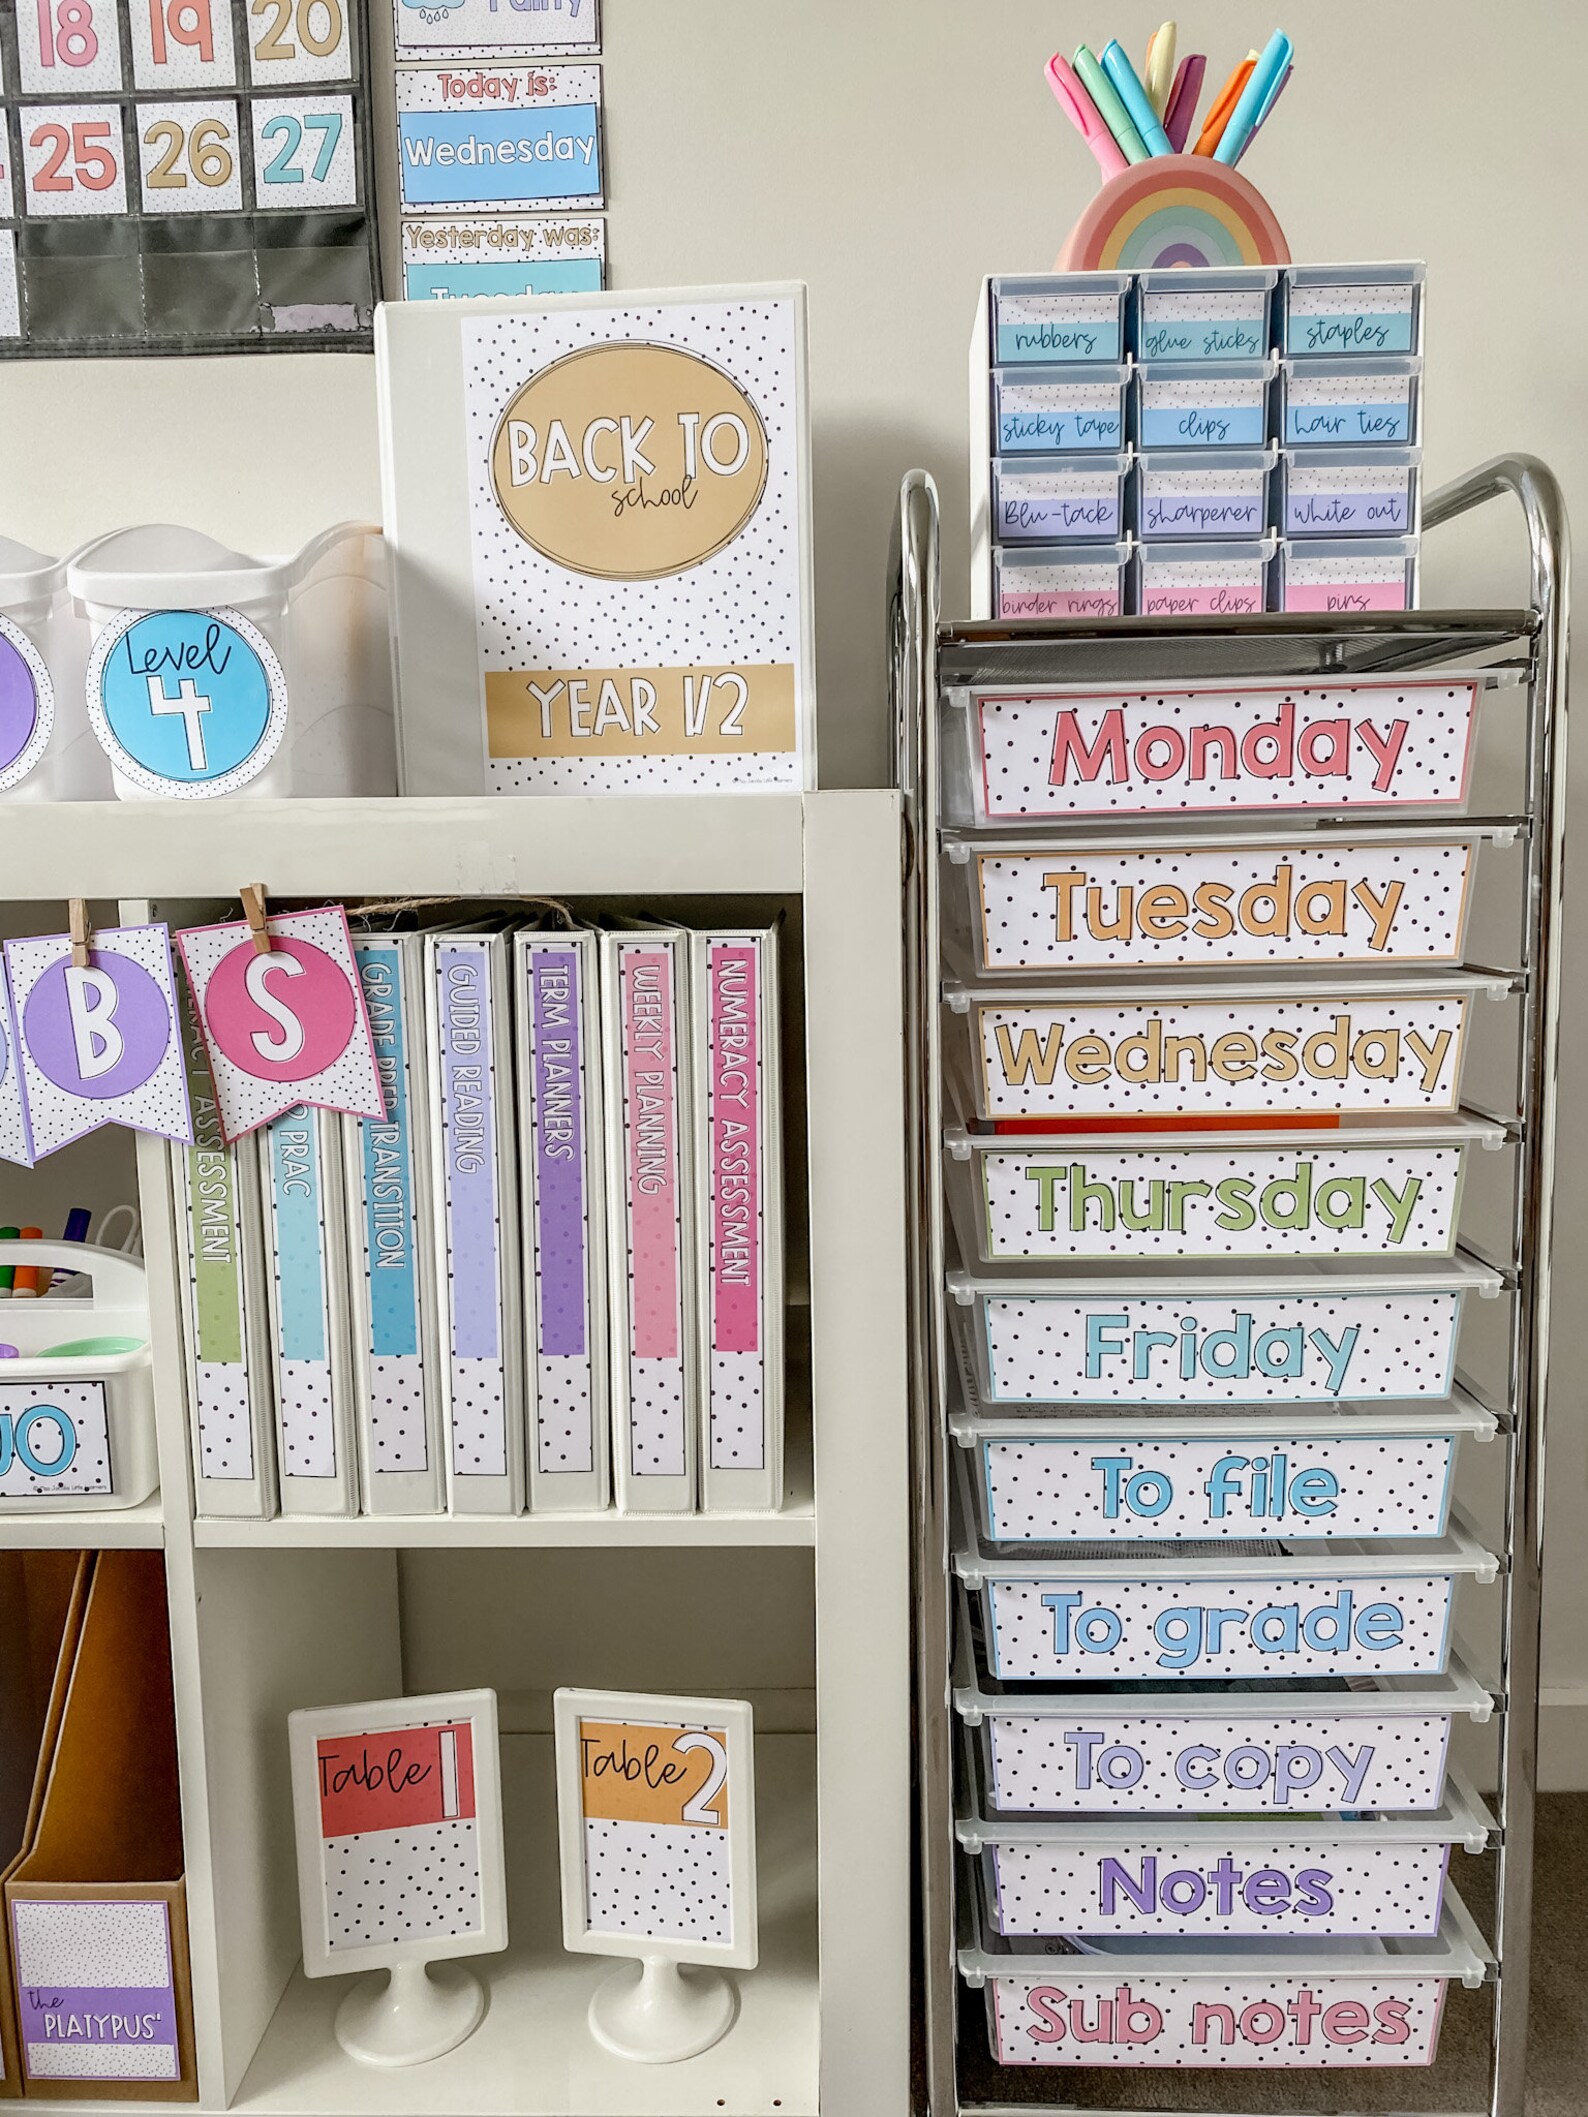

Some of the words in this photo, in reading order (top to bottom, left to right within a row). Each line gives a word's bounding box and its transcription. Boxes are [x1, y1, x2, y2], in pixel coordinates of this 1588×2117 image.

[37, 0, 98, 67] 18
[149, 0, 215, 64] 19
[251, 0, 342, 60] 20
[437, 72, 518, 103] Today
[527, 71, 557, 97] is:
[29, 121, 117, 191] 25
[143, 119, 232, 188] 26
[261, 113, 343, 184] 27
[404, 131, 595, 168] Wednesday
[406, 224, 534, 252] Yesterday
[543, 227, 600, 248] was:
[1015, 324, 1097, 353] rubbers
[1145, 327, 1192, 359] glue
[1203, 330, 1260, 355] sticks
[1305, 316, 1389, 349] staples
[507, 415, 656, 487] BACK
[678, 411, 750, 480] TO
[1003, 417, 1064, 445] sticky
[1075, 416, 1120, 444] tape
[1178, 411, 1230, 441] clips
[1294, 410, 1346, 435] hair
[1357, 410, 1400, 437] ties
[611, 475, 698, 517] school
[1004, 499, 1113, 528] Blu-tack
[1147, 498, 1258, 528] sharpener
[1294, 498, 1356, 523] white
[1367, 499, 1401, 522] out
[1002, 591, 1057, 615] binder
[1067, 598, 1118, 616] rings
[1147, 597, 1199, 615] paper
[1210, 588, 1257, 613] clips
[1326, 592, 1371, 613] pins
[126, 624, 232, 675] Level
[146, 675, 211, 770] 4
[526, 677, 661, 739] YEAR
[683, 672, 749, 738] 1/2
[1048, 703, 1409, 792] Monday
[1042, 864, 1405, 951] Tuesday
[63, 966, 124, 1080] B
[245, 952, 307, 1063] S
[360, 961, 393, 1047] GRADE
[447, 963, 481, 1056] GUIDED
[538, 964, 571, 1030] TERM
[631, 964, 665, 1062] WEEKLY
[717, 958, 750, 1110] NUMERACY
[994, 1015, 1452, 1093] Wednesday
[451, 1064, 485, 1175] READING
[541, 1038, 575, 1163] PLANNERS
[634, 1070, 668, 1196] PLANNING
[278, 1130, 311, 1198] PRAC
[368, 1120, 405, 1269] TRANSITION
[719, 1118, 750, 1288] ASSESSMENT
[1024, 1162, 1424, 1244] Thursday
[1085, 1313, 1359, 1392] Friday
[1091, 1456, 1173, 1519] To
[1204, 1454, 1339, 1518] file
[1041, 1593, 1122, 1654] To
[1154, 1589, 1404, 1669] grade
[318, 1748, 432, 1797] Table
[438, 1730, 461, 1819] 1
[580, 1738, 687, 1790] Table
[672, 1731, 728, 1826] 2
[1064, 1731, 1144, 1790] To
[1175, 1744, 1376, 1805] copy
[1099, 1856, 1334, 1916] Notes
[27, 1988, 64, 2010] the
[1026, 1985, 1163, 2044] Sub
[1191, 1990, 1412, 2045] notes
